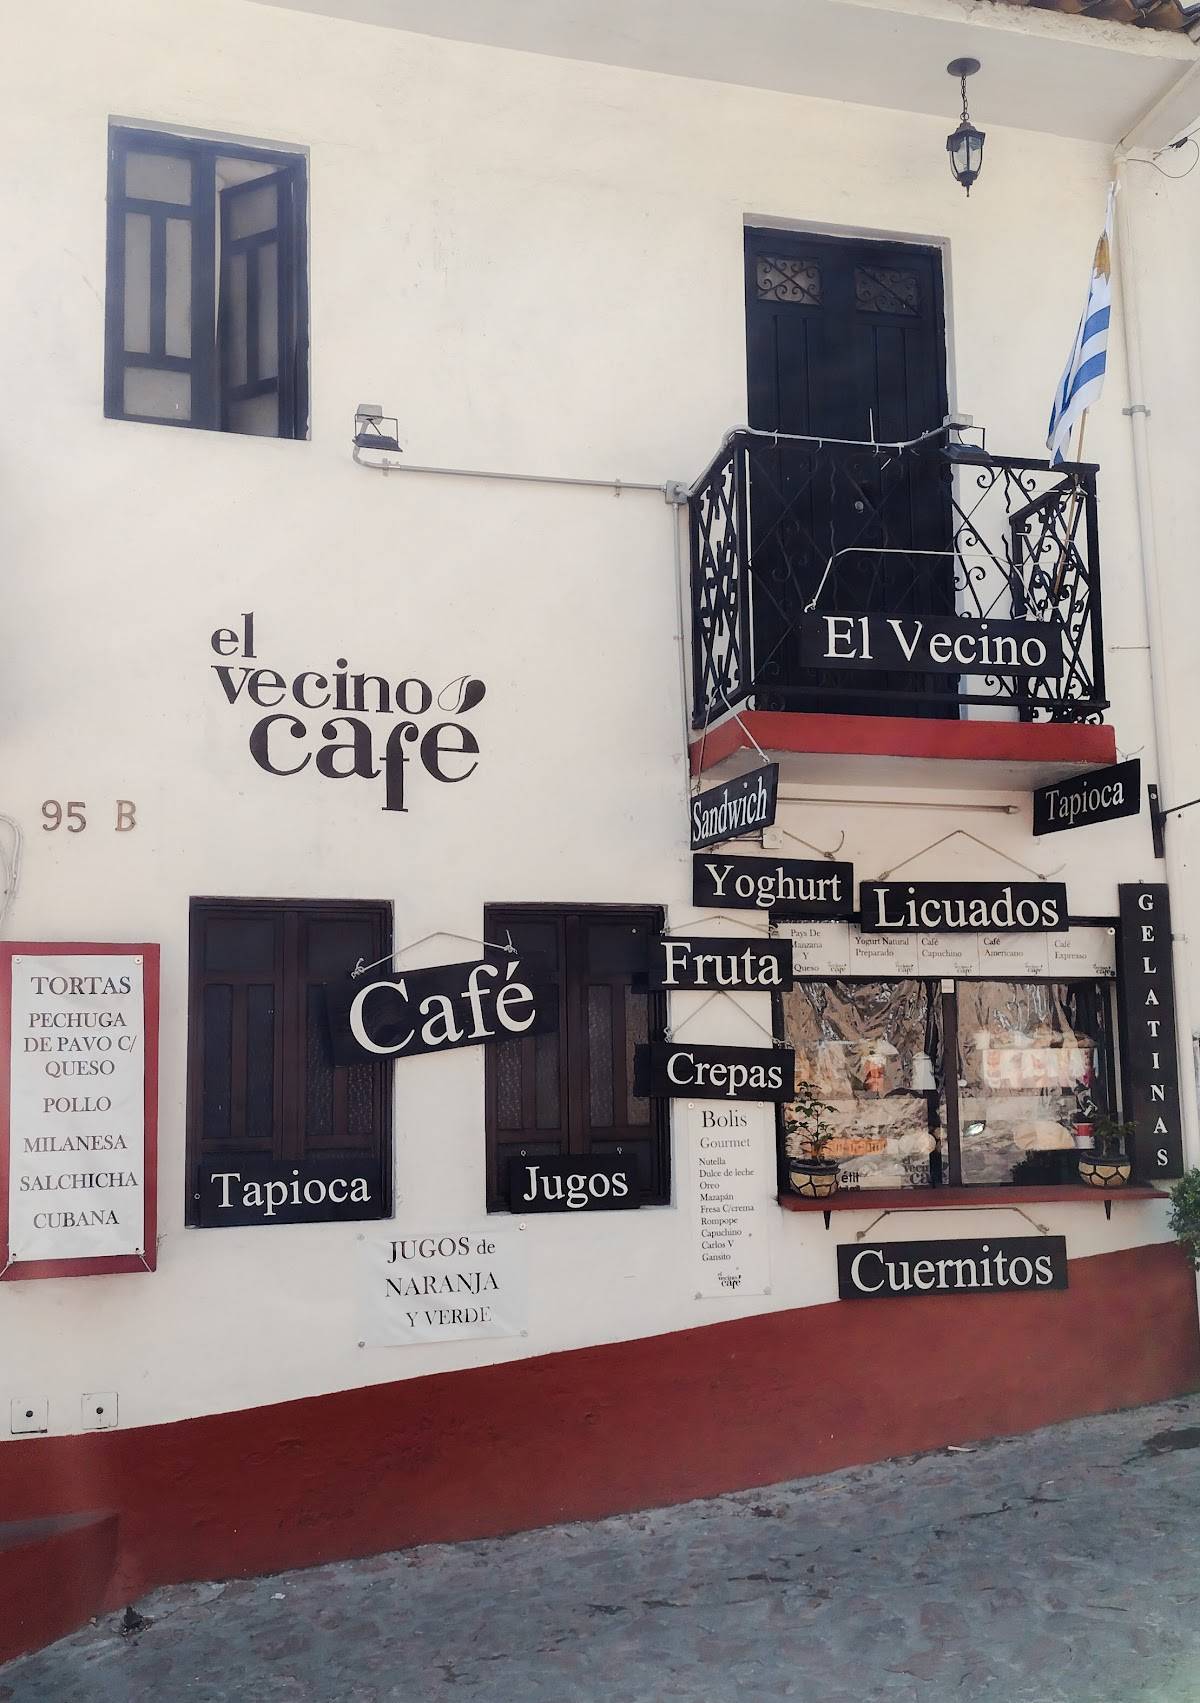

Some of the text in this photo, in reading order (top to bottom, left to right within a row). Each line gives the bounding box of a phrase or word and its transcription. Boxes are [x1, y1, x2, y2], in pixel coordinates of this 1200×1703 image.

[211, 612, 257, 658] el
[823, 616, 1047, 666] El Vecino
[210, 658, 433, 715] vecino
[692, 776, 767, 842] Sandwich
[1046, 782, 1126, 826] Tapioca
[42, 800, 136, 833] 95 B
[704, 863, 842, 907] Yoghurt
[873, 887, 1059, 927] Licuados
[854, 935, 909, 946] Yogurt Natural
[921, 935, 940, 946] Café
[983, 937, 1001, 946] Café
[661, 942, 782, 985] Fruta
[31, 976, 131, 995] TORTAS
[350, 960, 535, 1055] Café
[30, 1012, 127, 1027] PECHUGA
[1138, 893, 1169, 1166] GELATINAS
[24, 1036, 136, 1053] DE PAVO C/
[46, 1060, 115, 1078] QUESO
[667, 1053, 782, 1095] Crepas
[44, 1097, 111, 1112] POLLO
[703, 1110, 746, 1127] Bolis
[25, 1135, 127, 1152] MILANESA
[699, 1137, 751, 1149] Gourmet
[698, 1157, 726, 1166] Nutella
[21, 1172, 138, 1191] SALCHICHA
[699, 1167, 755, 1178] Dulce de leche
[211, 1170, 371, 1215] Tapioca
[523, 1166, 628, 1208] Jugos
[699, 1181, 720, 1190] Oreo
[699, 1193, 734, 1203] Mazapán
[700, 1204, 721, 1214] Fresa
[34, 1210, 119, 1228] CUBANA
[701, 1217, 738, 1227] Rompope
[701, 1228, 743, 1239] Capuchino
[388, 1237, 495, 1263] JUGOS de
[701, 1239, 734, 1250] Carlos V
[701, 1253, 732, 1262] Gansito
[850, 1244, 1054, 1292] Cuernitos
[386, 1272, 499, 1296] NARANJA
[406, 1307, 489, 1327] Y VERDE
